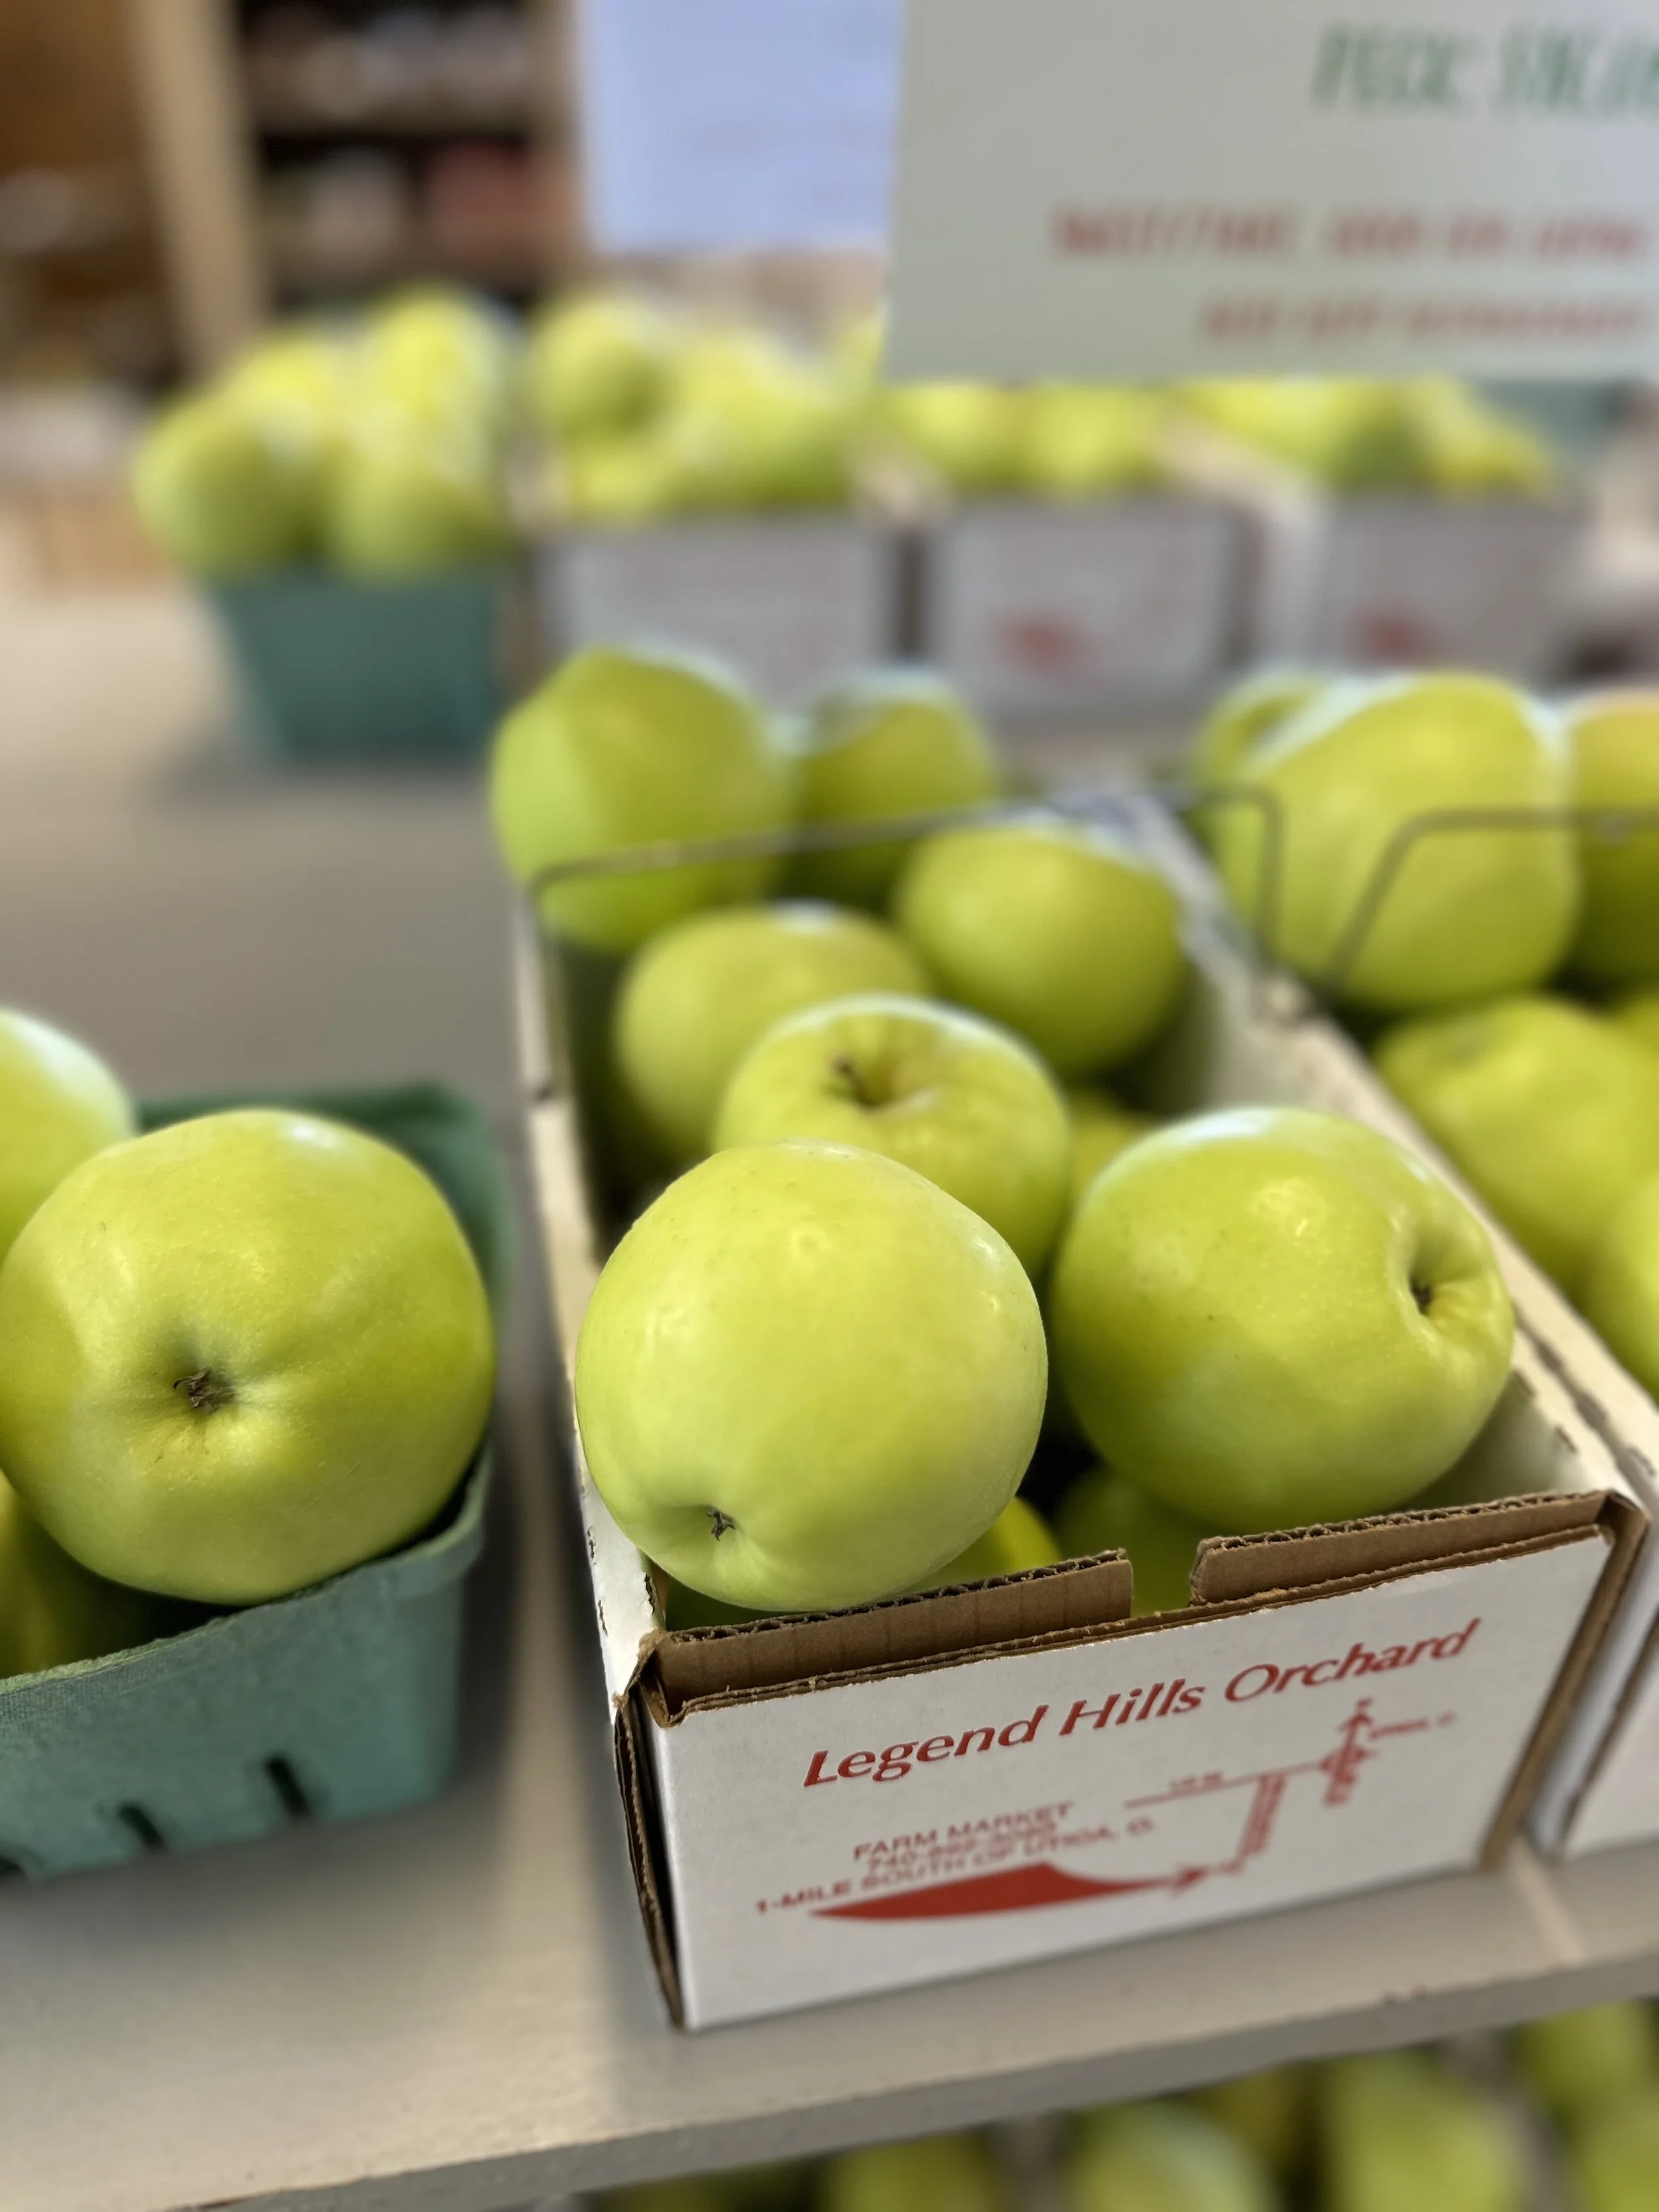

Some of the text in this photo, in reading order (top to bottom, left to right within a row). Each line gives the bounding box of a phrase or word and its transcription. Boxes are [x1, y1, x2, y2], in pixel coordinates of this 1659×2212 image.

[803, 1616, 1482, 1787] Legend Hills Orchard
[852, 1801, 1074, 1861] FARM MARKET
[755, 1880, 852, 1914] 1-MILE
